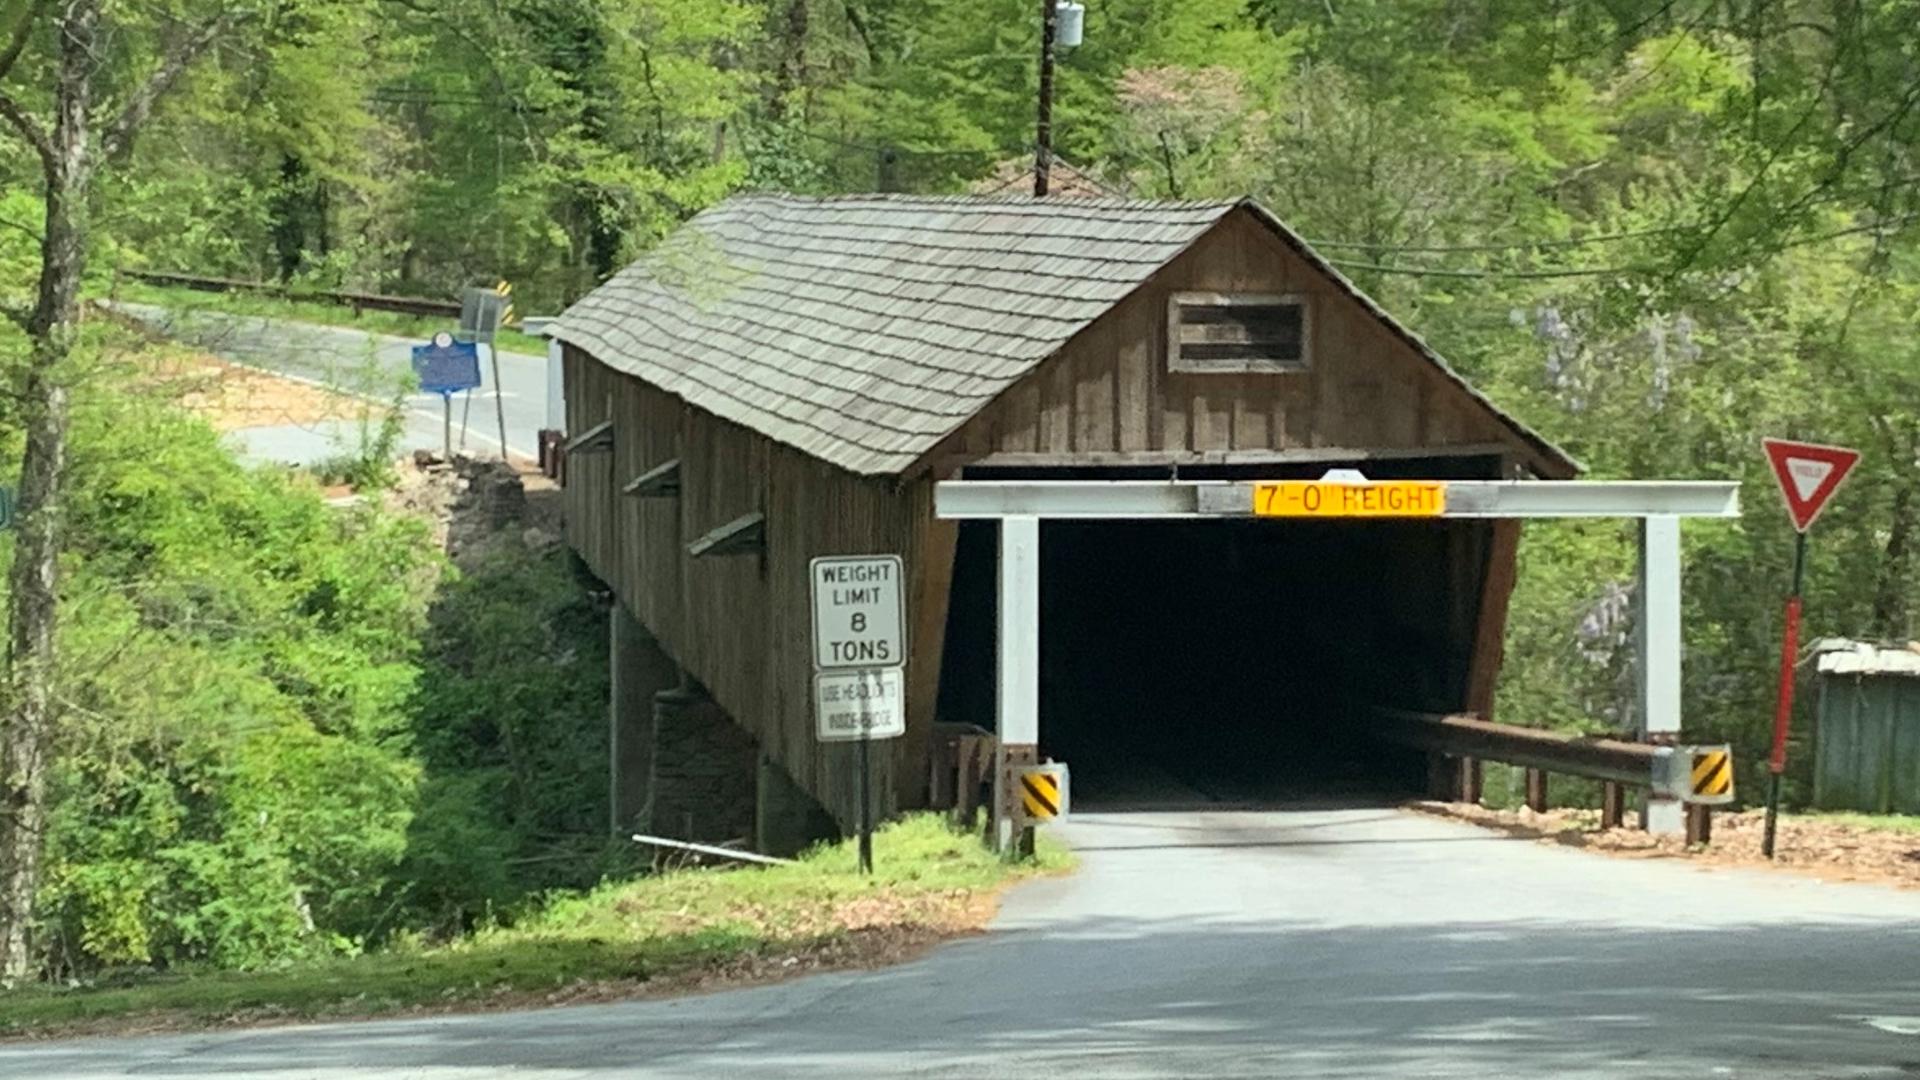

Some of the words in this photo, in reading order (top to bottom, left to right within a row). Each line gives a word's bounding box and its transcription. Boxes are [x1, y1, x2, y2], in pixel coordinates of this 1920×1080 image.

[1342, 485, 1438, 511] HEIGHT
[822, 564, 890, 583] WEIGHT
[833, 587, 880, 605] LIMIT
[850, 612, 866, 632] 8
[830, 640, 889, 661] TONS
